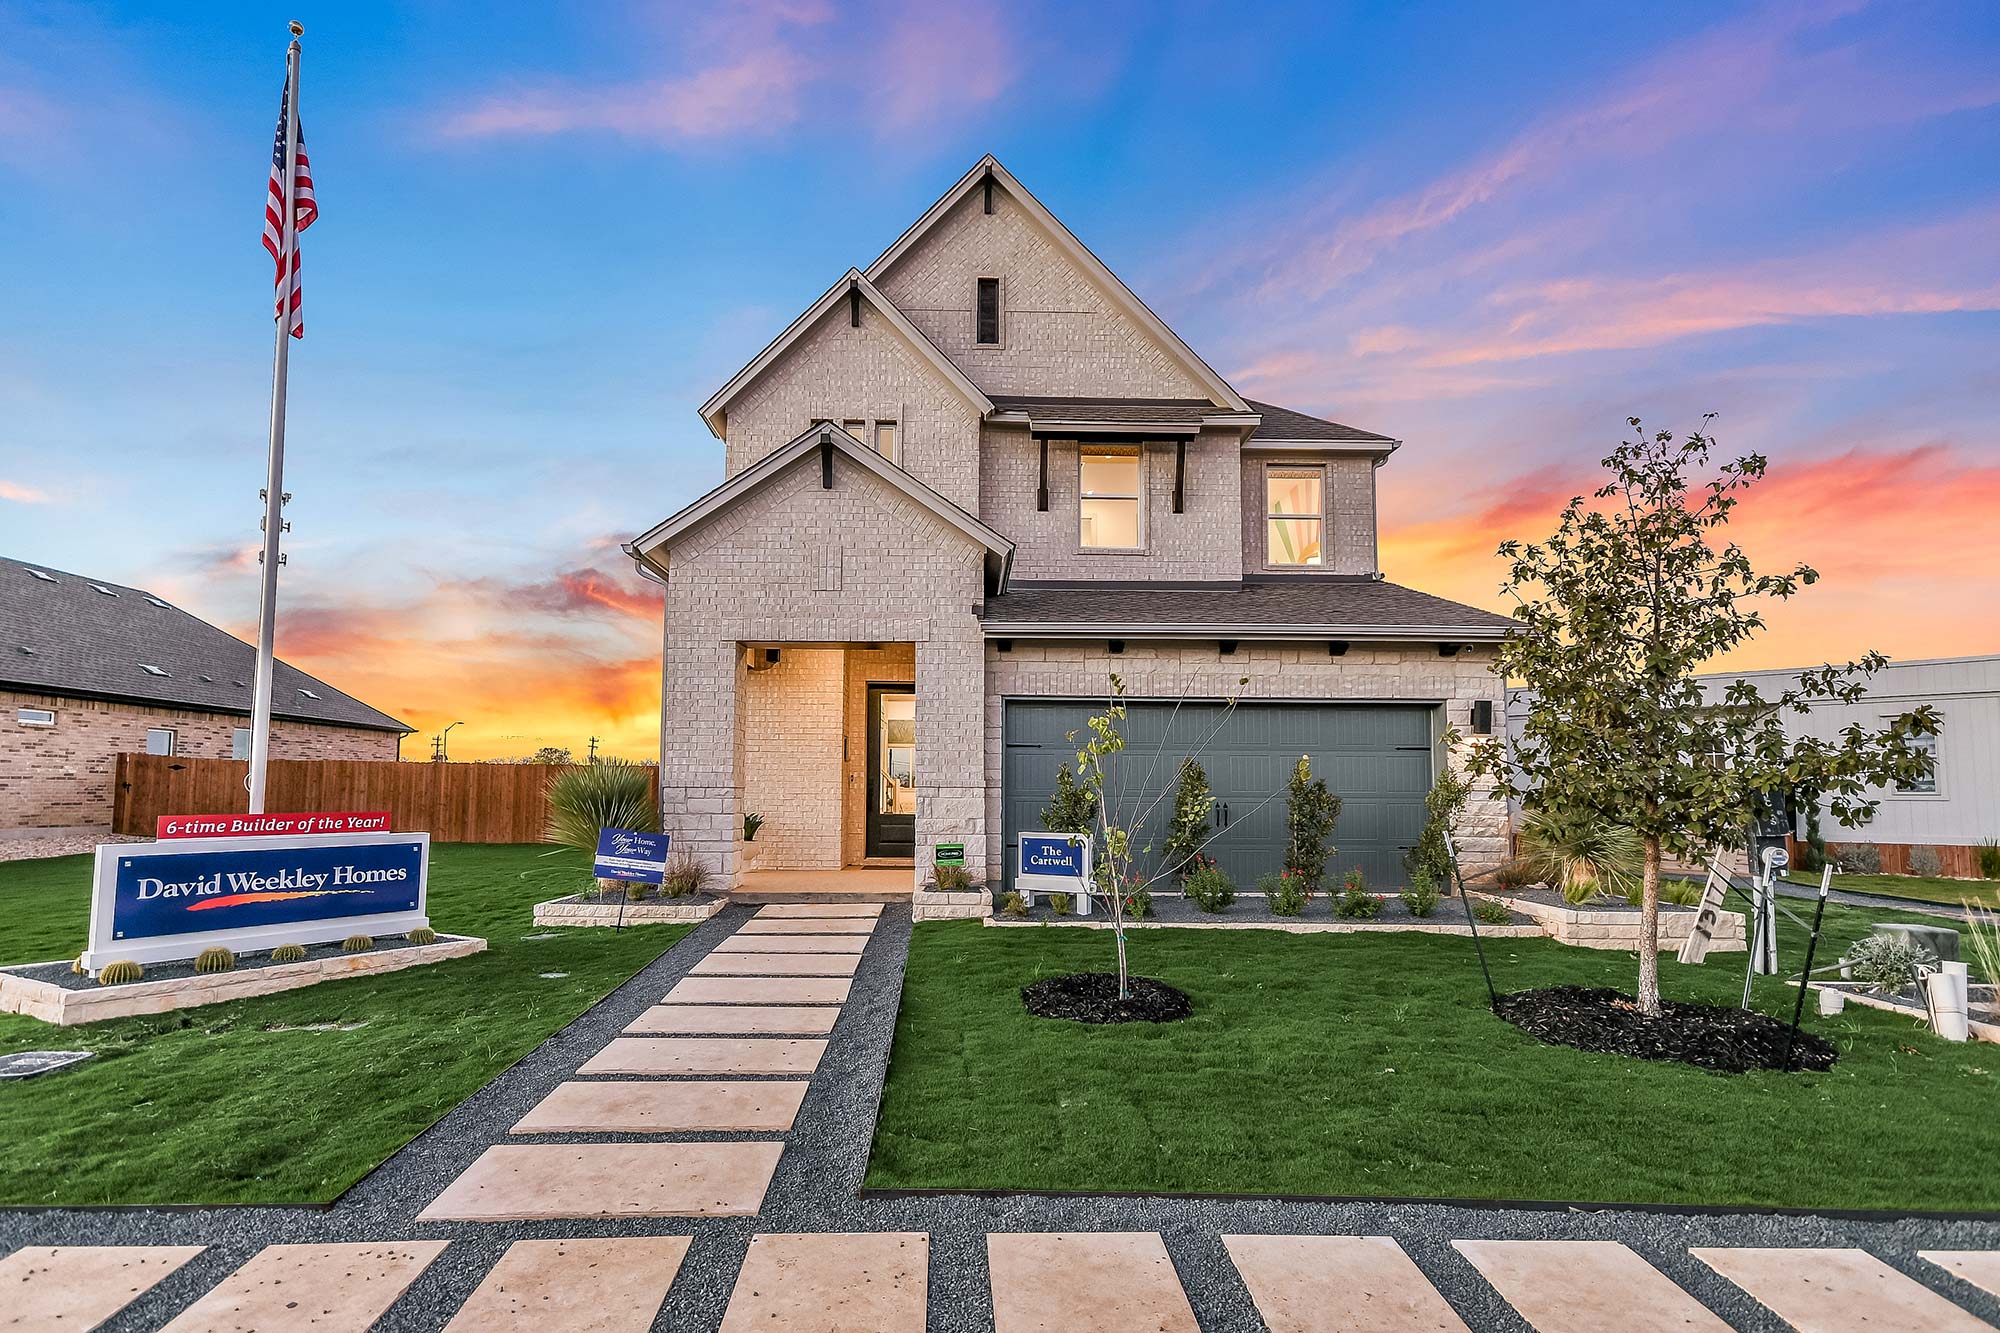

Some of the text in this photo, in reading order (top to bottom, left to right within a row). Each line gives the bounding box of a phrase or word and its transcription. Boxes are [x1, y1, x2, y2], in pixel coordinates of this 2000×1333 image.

[166, 816, 385, 834] 6-time Builder of the Year!
[611, 833, 633, 845] Your
[614, 843, 652, 857] Your Way
[1041, 845, 1062, 856] The
[1030, 855, 1073, 867] Cartwell
[136, 865, 407, 900] David Weekley Homes
